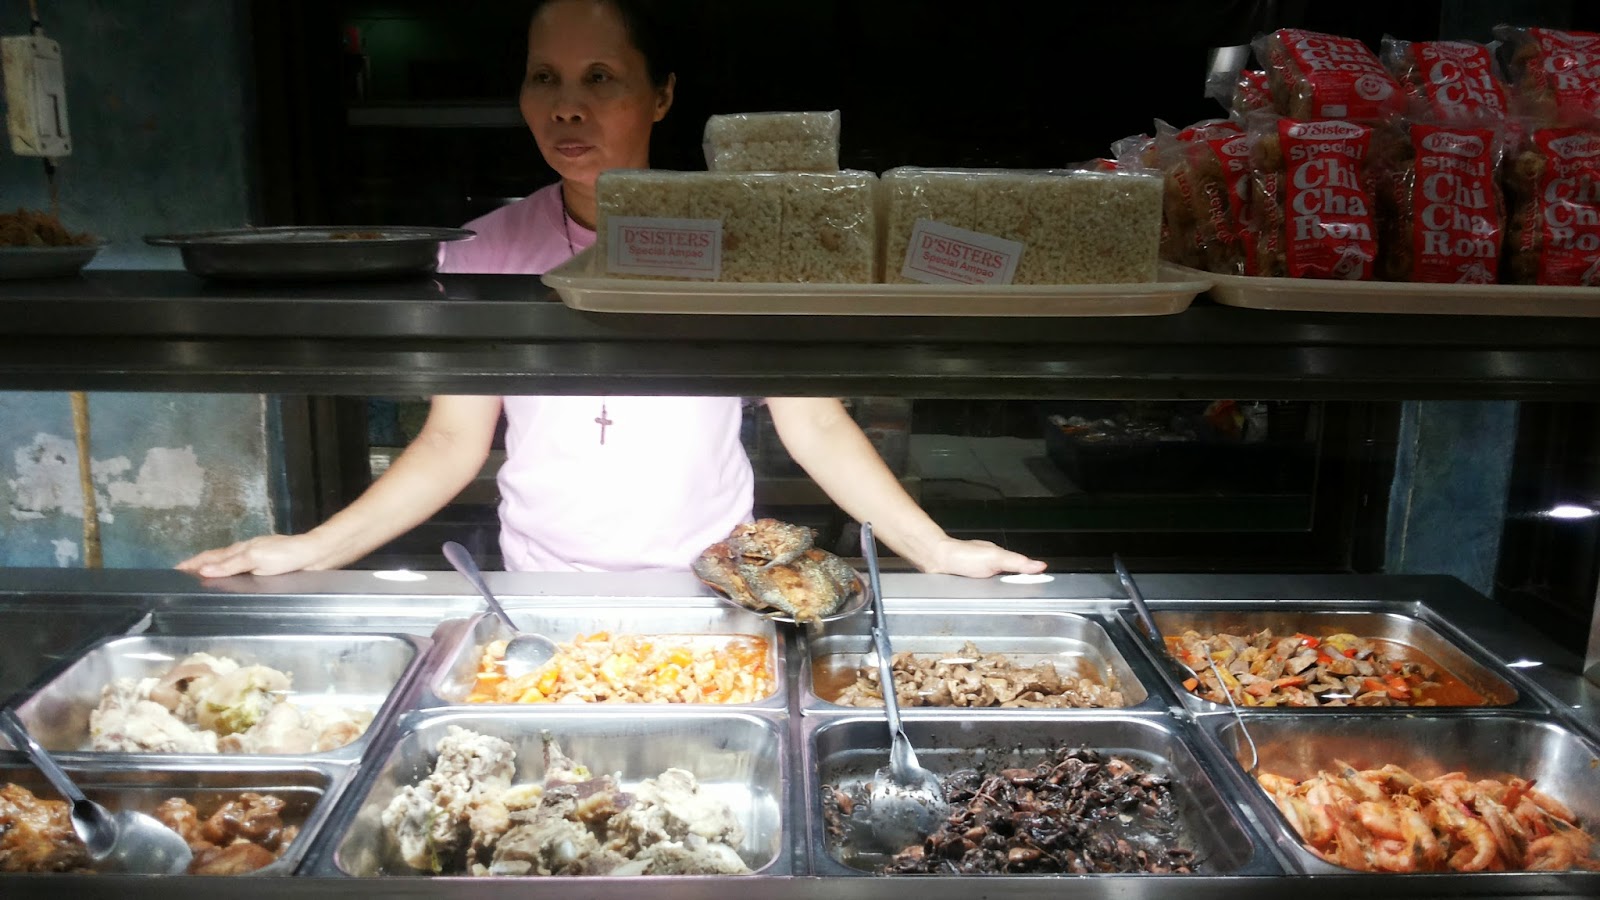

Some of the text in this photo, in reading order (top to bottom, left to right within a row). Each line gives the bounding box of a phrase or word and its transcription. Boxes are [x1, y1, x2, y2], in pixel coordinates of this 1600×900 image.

[1307, 60, 1385, 74] Ron
[1296, 123, 1362, 138] D'Sisters
[1289, 140, 1364, 161] Special
[1293, 157, 1362, 192] Chi
[1292, 188, 1369, 217] Cha
[1423, 172, 1489, 210] Chi
[1293, 214, 1372, 241] Ron
[1421, 203, 1497, 236] Cha
[624, 229, 710, 248] D'SISTERS
[628, 245, 705, 259] Special Ampao
[921, 235, 1003, 269] D'SISTERS
[1421, 230, 1497, 258] Ron
[922, 251, 959, 268] Special
[960, 262, 995, 279] Ampao
